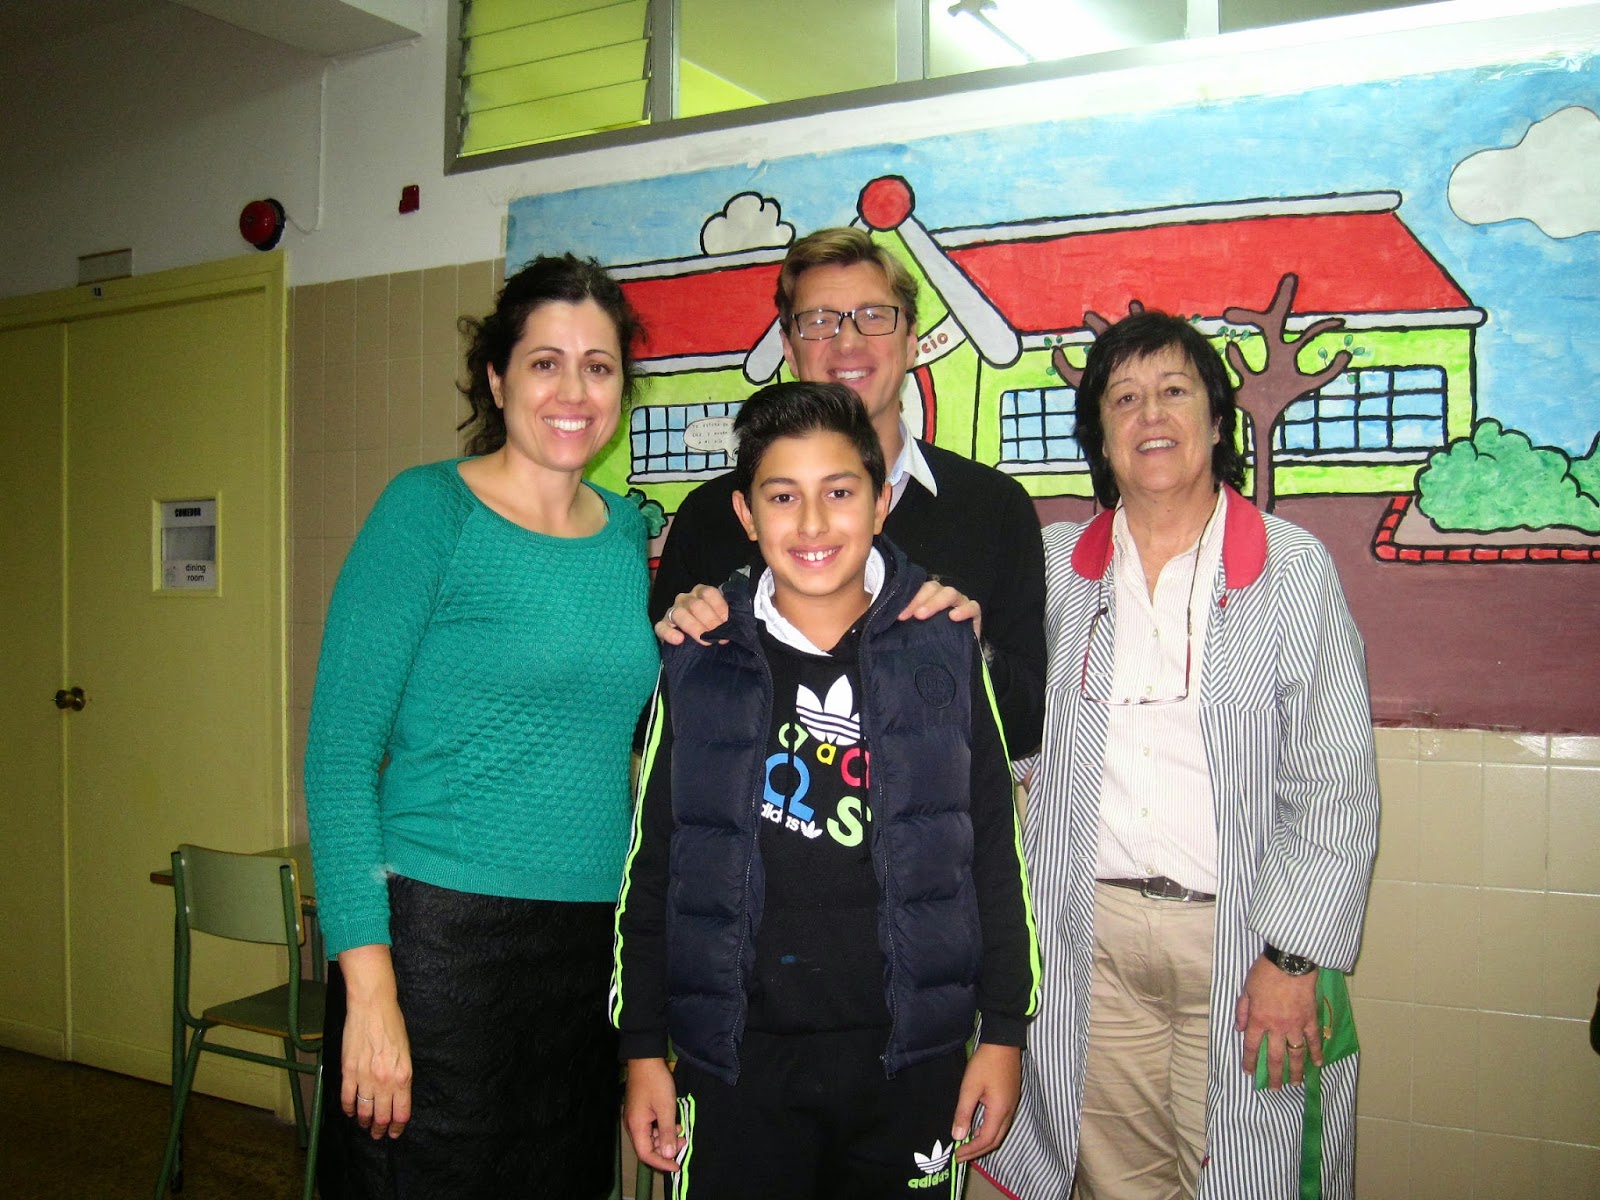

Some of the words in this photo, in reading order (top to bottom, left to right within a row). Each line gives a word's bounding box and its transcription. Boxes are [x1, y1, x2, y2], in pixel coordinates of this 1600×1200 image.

[915, 333, 948, 358] cio
[185, 563, 207, 574] dining
[187, 574, 205, 582] room
[907, 1168, 950, 1189] adidas
